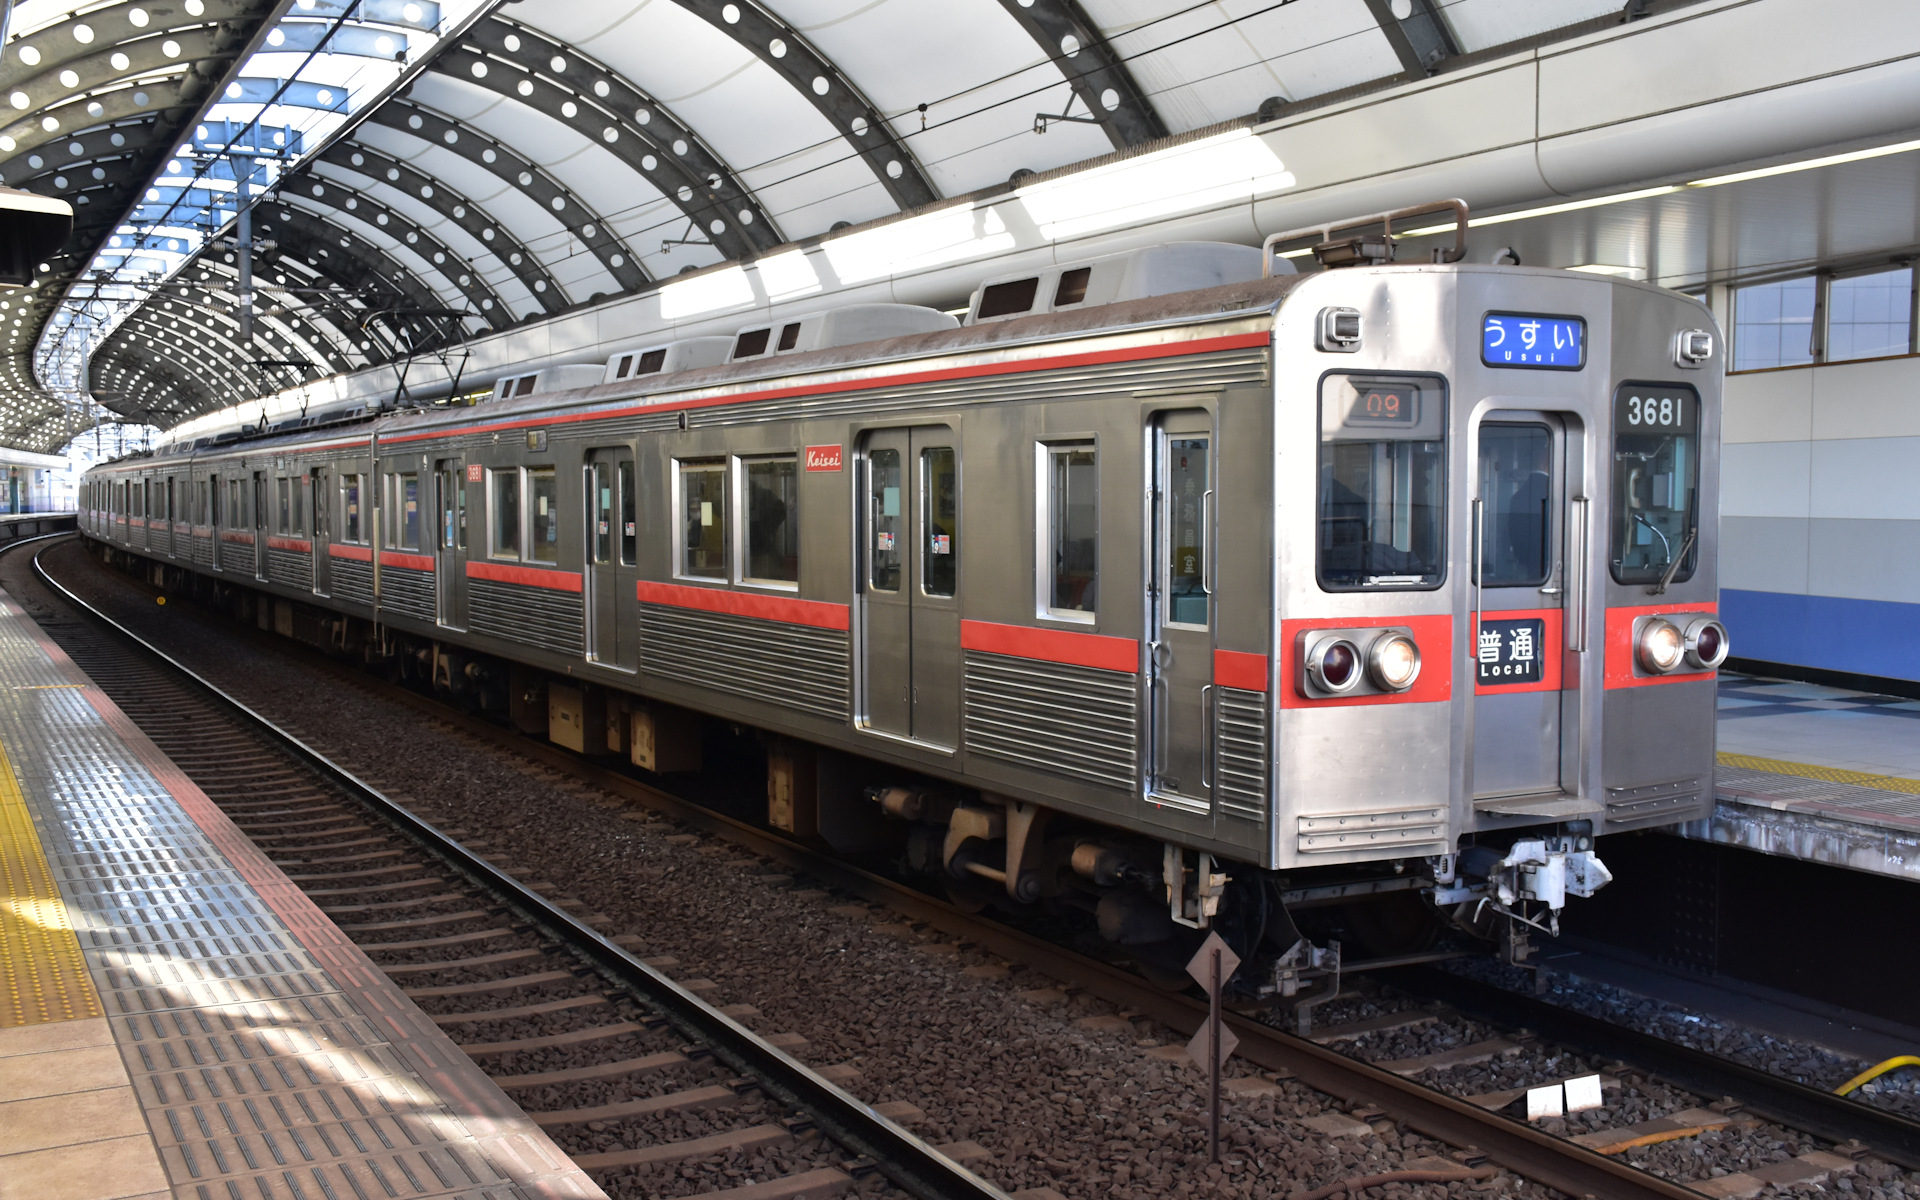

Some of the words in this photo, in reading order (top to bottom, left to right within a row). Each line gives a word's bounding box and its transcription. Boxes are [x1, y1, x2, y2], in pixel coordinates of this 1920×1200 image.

[1485, 319, 1574, 349] うすい
[1505, 351, 1555, 363] Usui
[1628, 396, 1682, 427] 3681
[807, 451, 841, 467] Keisei
[1479, 628, 1534, 663] 普通
[1481, 661, 1530, 677] Local
